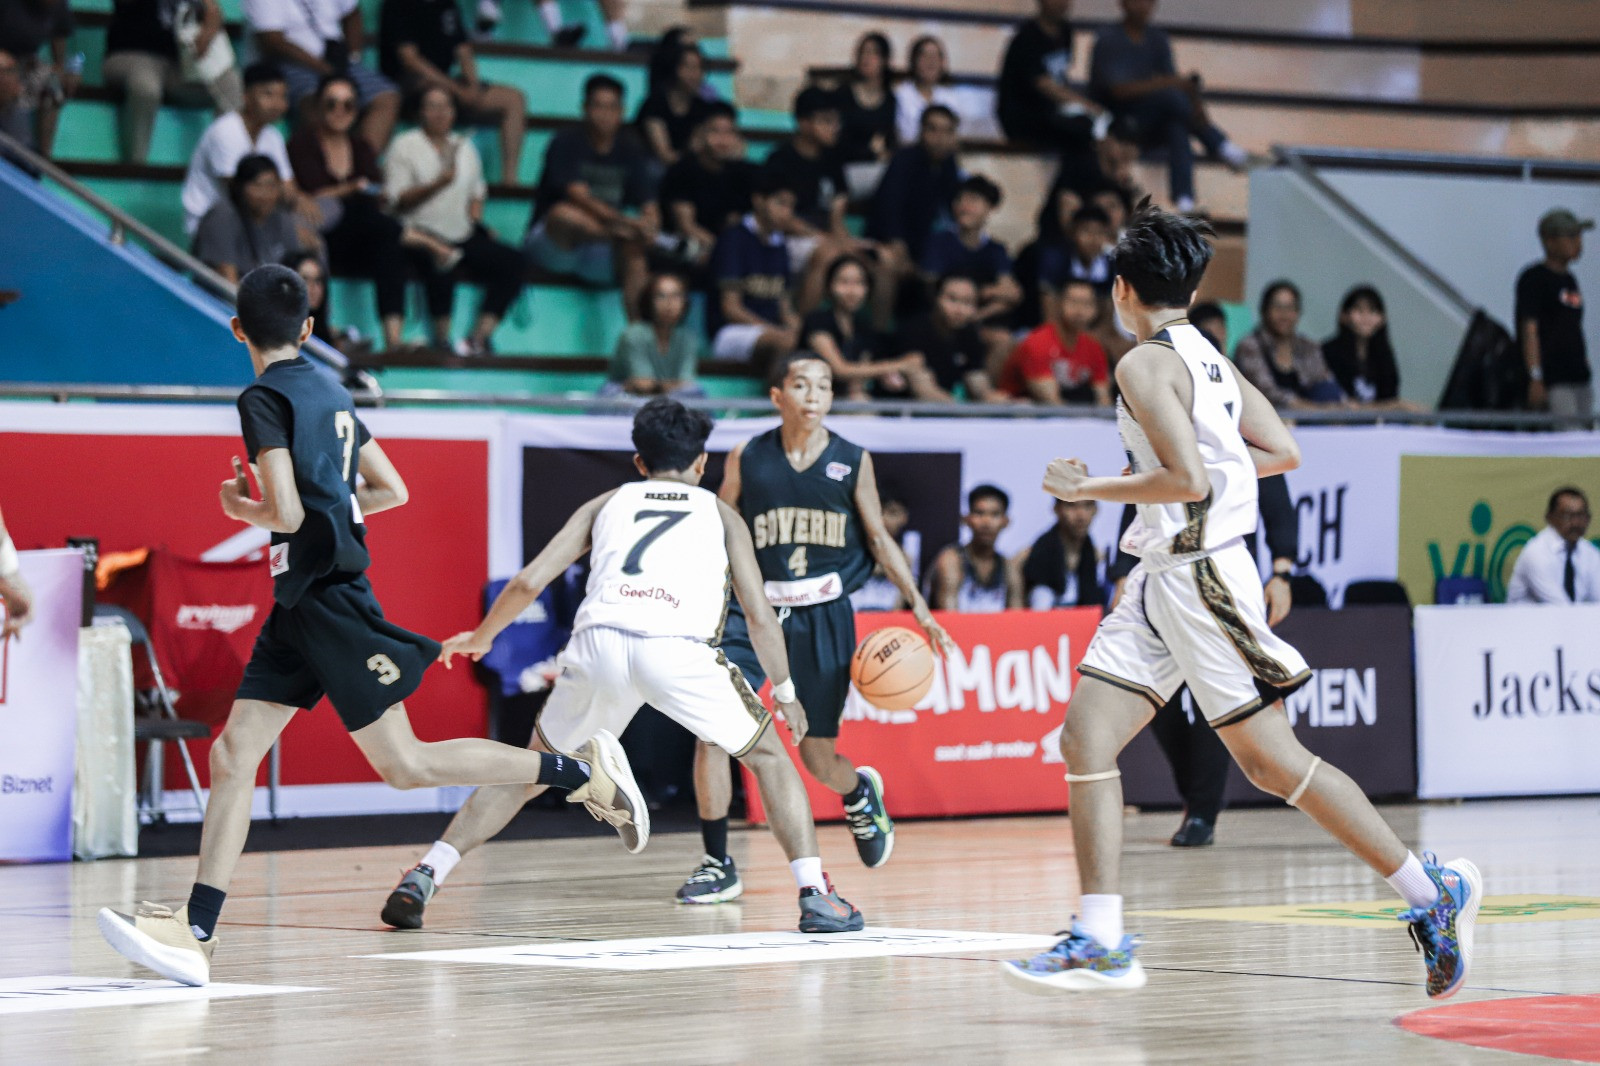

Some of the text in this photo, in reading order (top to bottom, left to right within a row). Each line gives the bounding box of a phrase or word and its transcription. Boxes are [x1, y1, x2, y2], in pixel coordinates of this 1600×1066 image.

[621, 509, 692, 576] 7
[753, 506, 847, 549] SOVERDI
[788, 546, 808, 577] 4
[655, 587, 681, 608] Day
[366, 653, 401, 686] 3
[2, 775, 53, 794] Biznet
